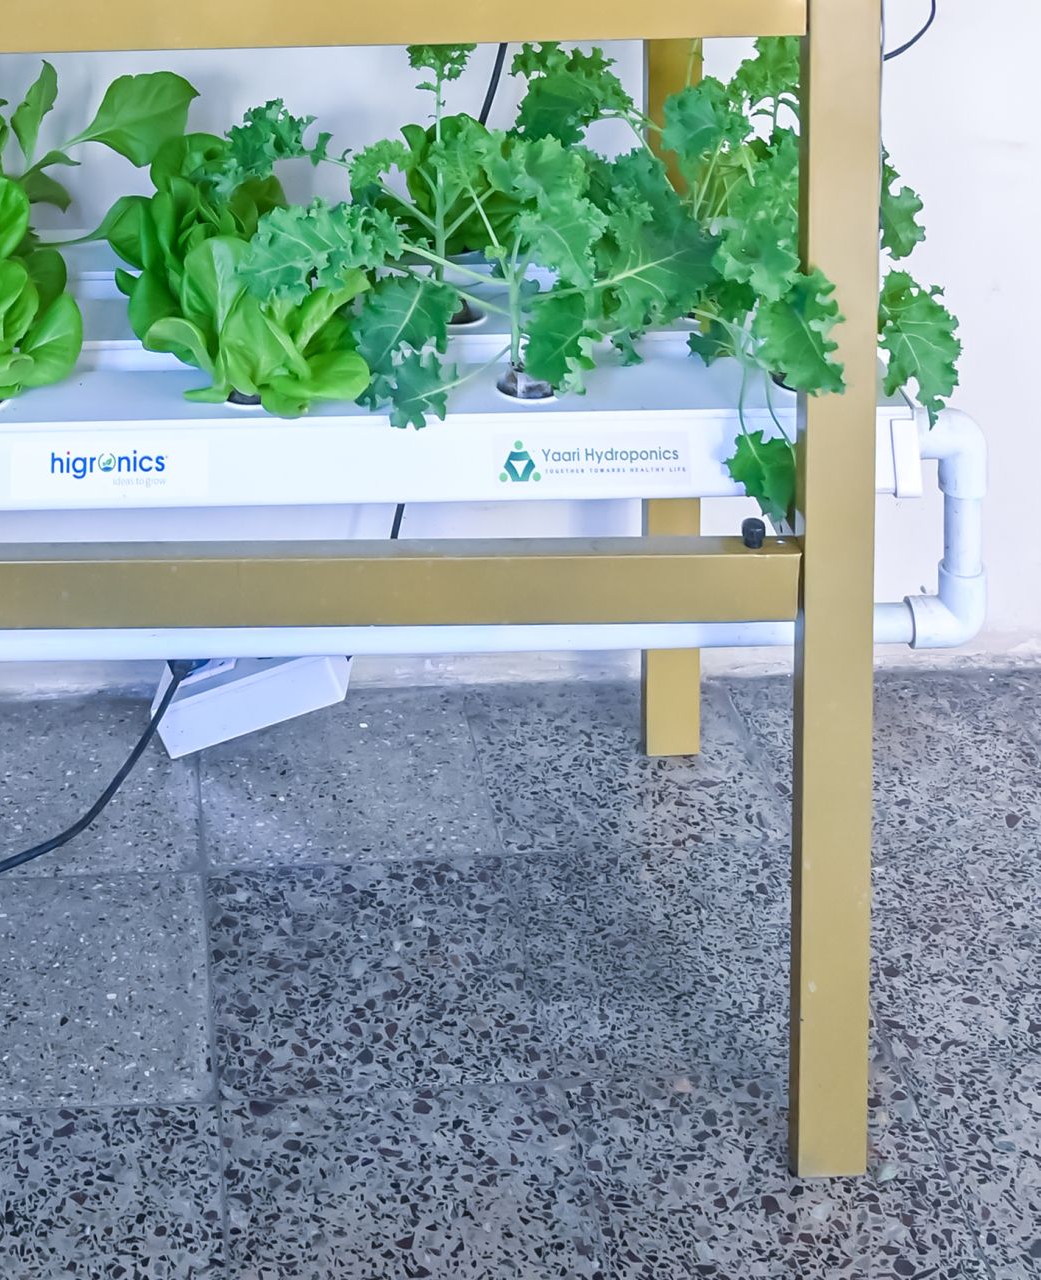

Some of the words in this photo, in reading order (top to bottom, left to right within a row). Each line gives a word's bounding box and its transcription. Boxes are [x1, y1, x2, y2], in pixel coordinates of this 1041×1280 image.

[50, 449, 166, 480] higronics
[541, 448, 580, 462] Yaari
[584, 446, 679, 464] Hydroponics
